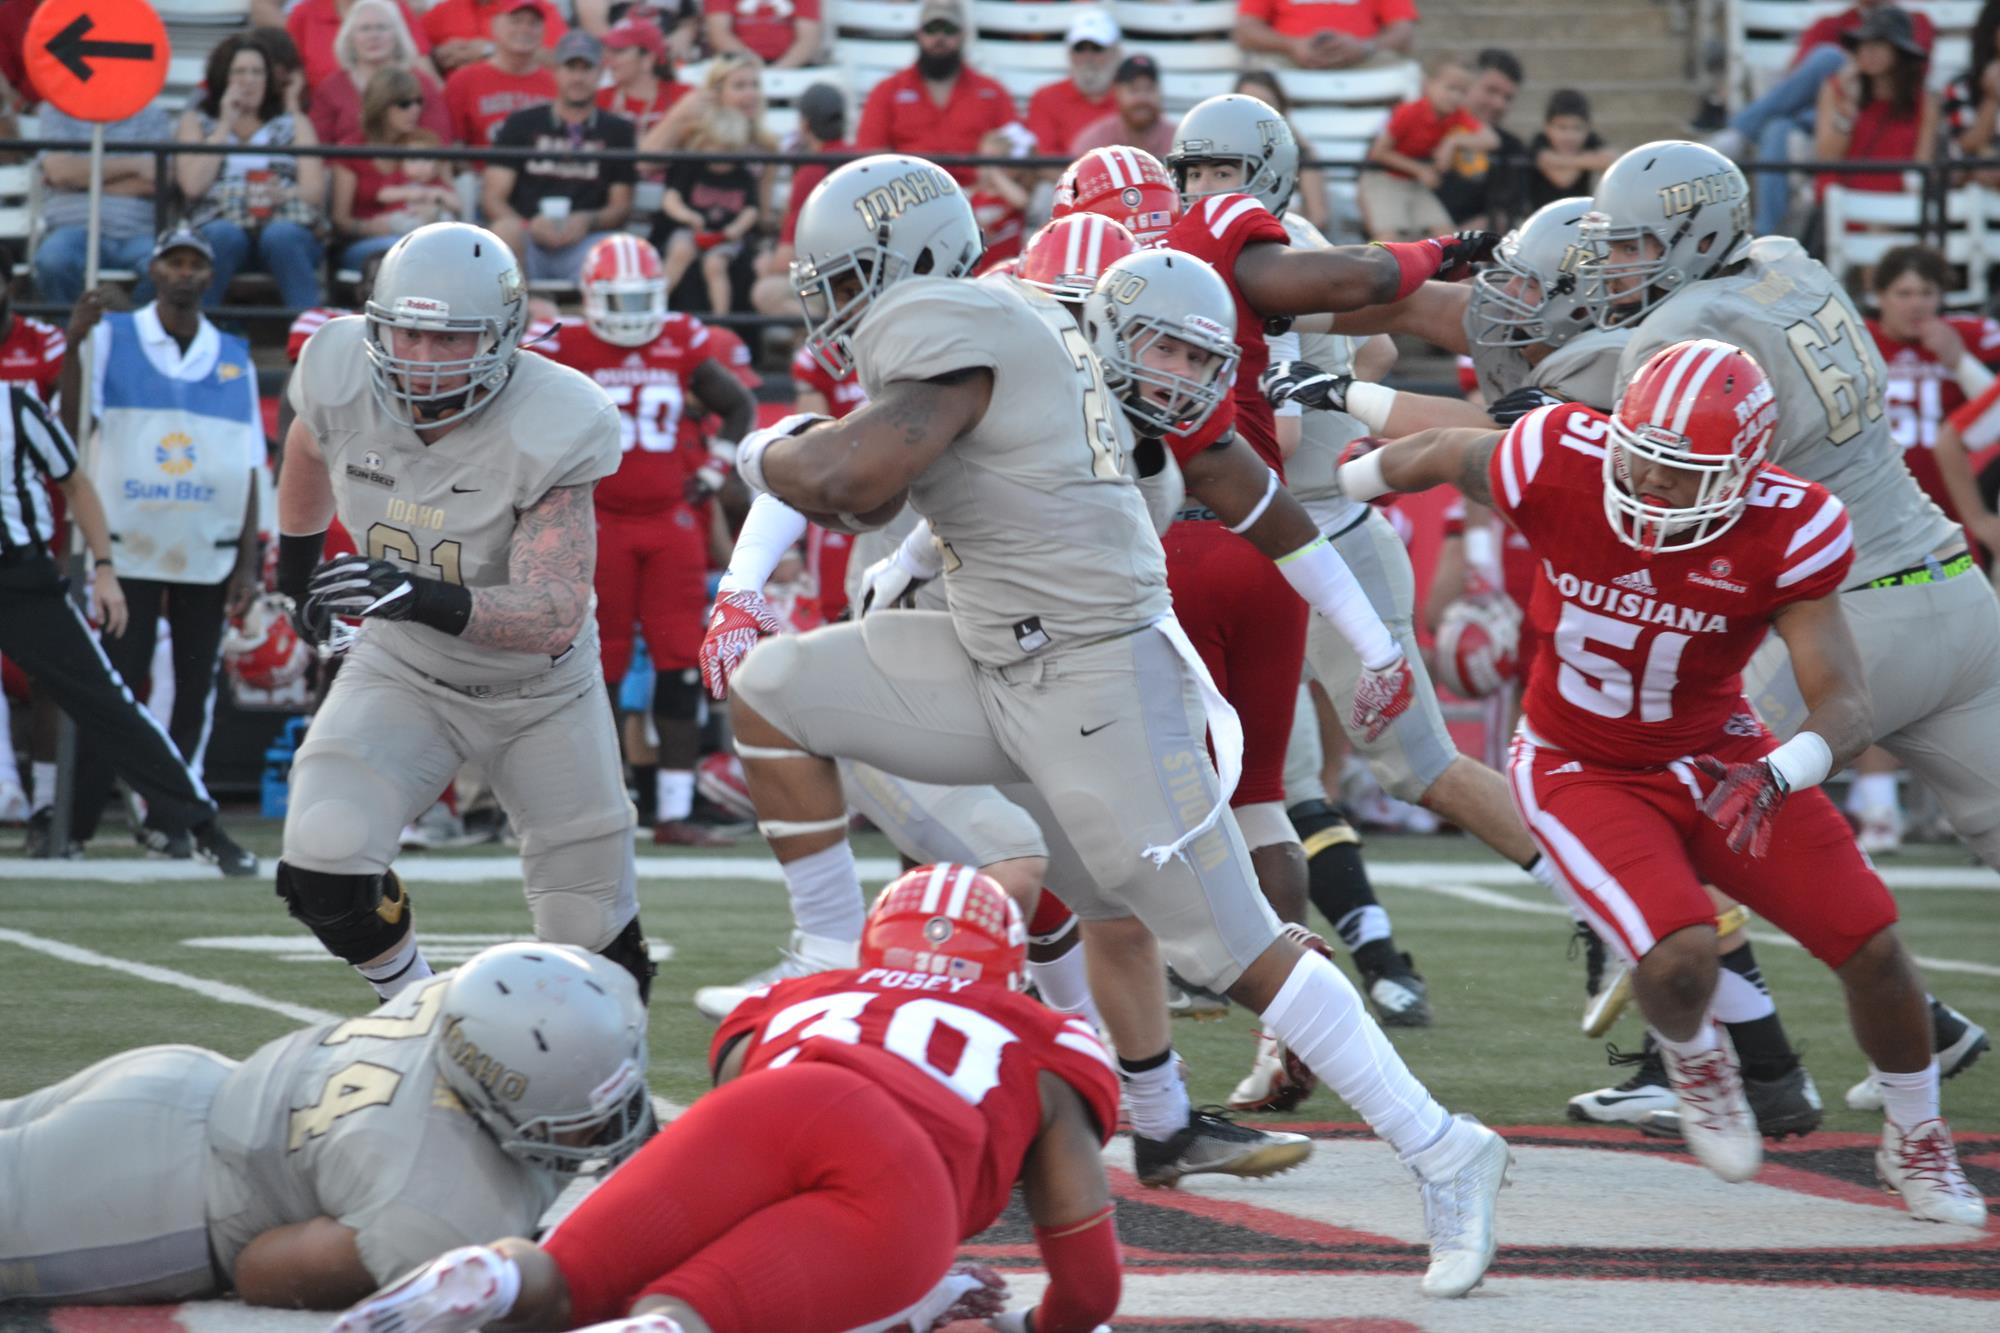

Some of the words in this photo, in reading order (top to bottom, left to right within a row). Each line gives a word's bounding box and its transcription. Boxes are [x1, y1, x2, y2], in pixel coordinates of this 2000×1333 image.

[854, 166, 956, 232] IDAHO
[1658, 171, 1742, 218] IDAHO
[1784, 292, 1884, 447] 67
[1559, 411, 1610, 459] 51
[124, 479, 170, 499] SUN
[1742, 471, 1813, 510] 51
[386, 497, 445, 531] IDAHO
[1541, 557, 1729, 634] LOUISIANA
[1554, 600, 1694, 723] 51
[857, 968, 973, 993] POSEY
[760, 991, 1022, 1107] 30
